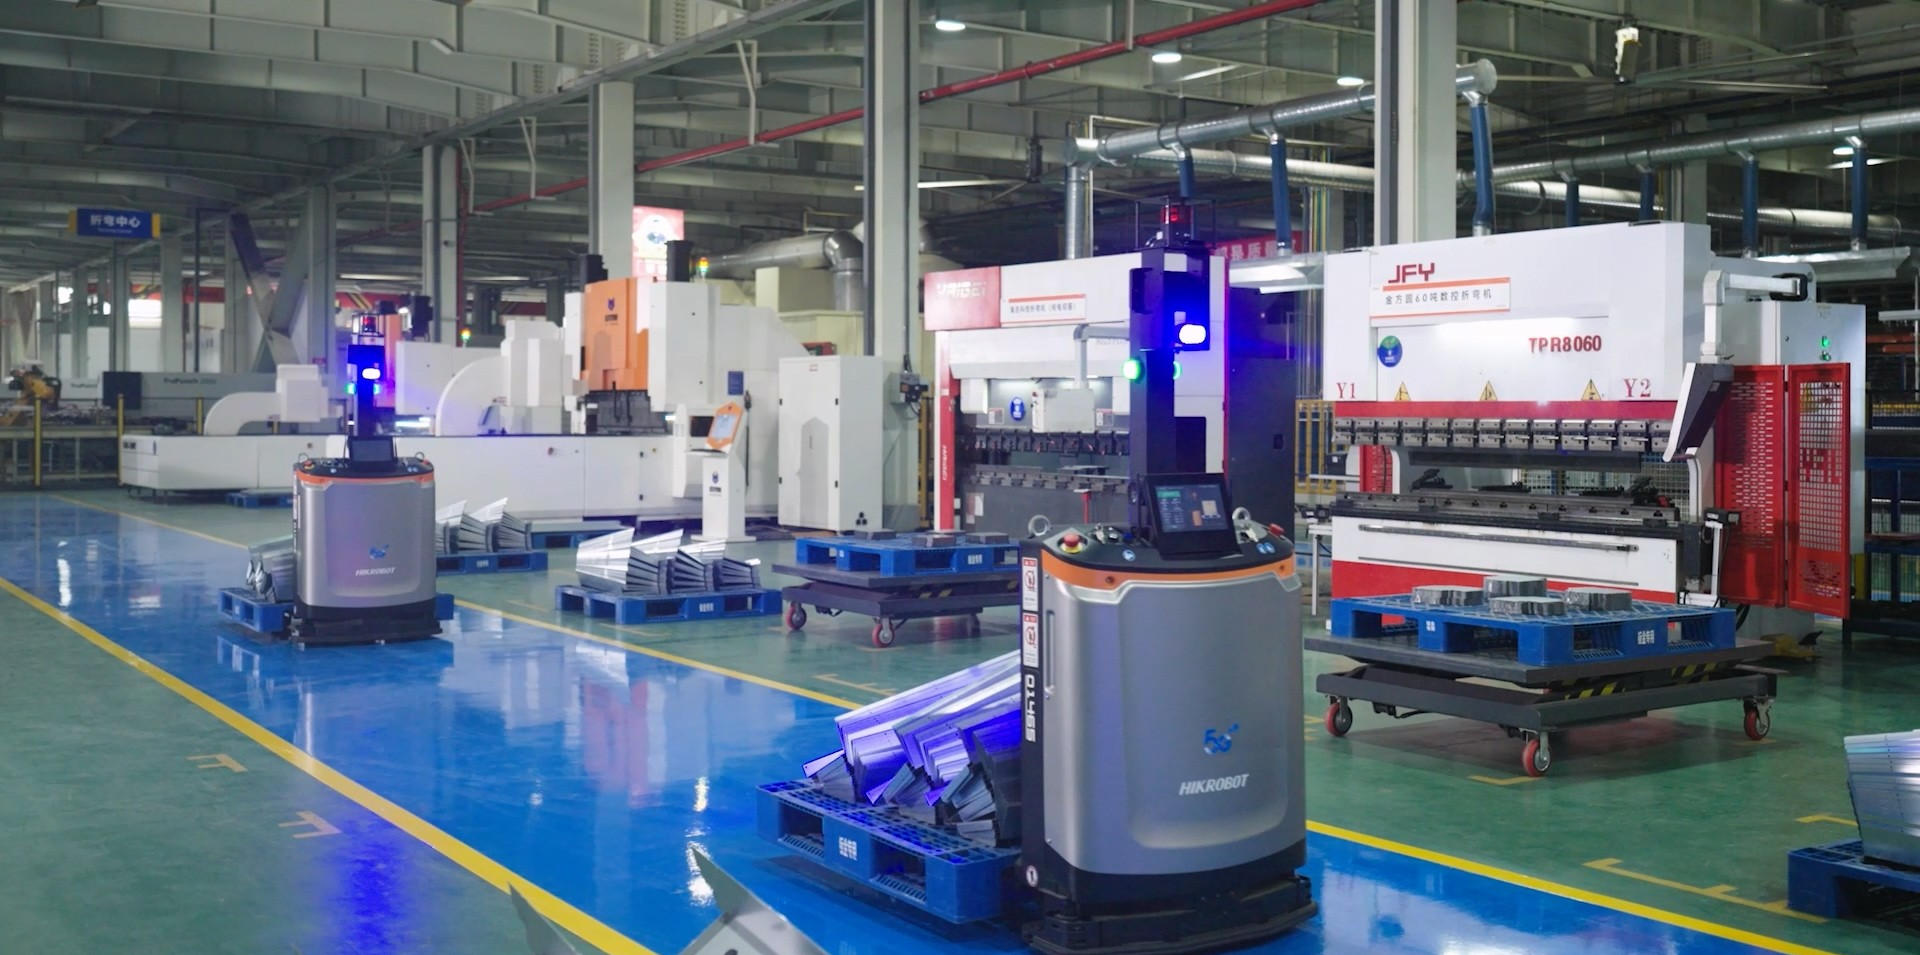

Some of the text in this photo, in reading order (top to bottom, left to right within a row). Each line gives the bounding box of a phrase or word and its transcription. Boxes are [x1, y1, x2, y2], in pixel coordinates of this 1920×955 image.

[1387, 262, 1435, 283] JFY
[1528, 335, 1602, 353] TPR8060
[1336, 382, 1356, 399] Y1
[1623, 378, 1651, 398] Y2
[1179, 773, 1250, 796] HIKROBOT
